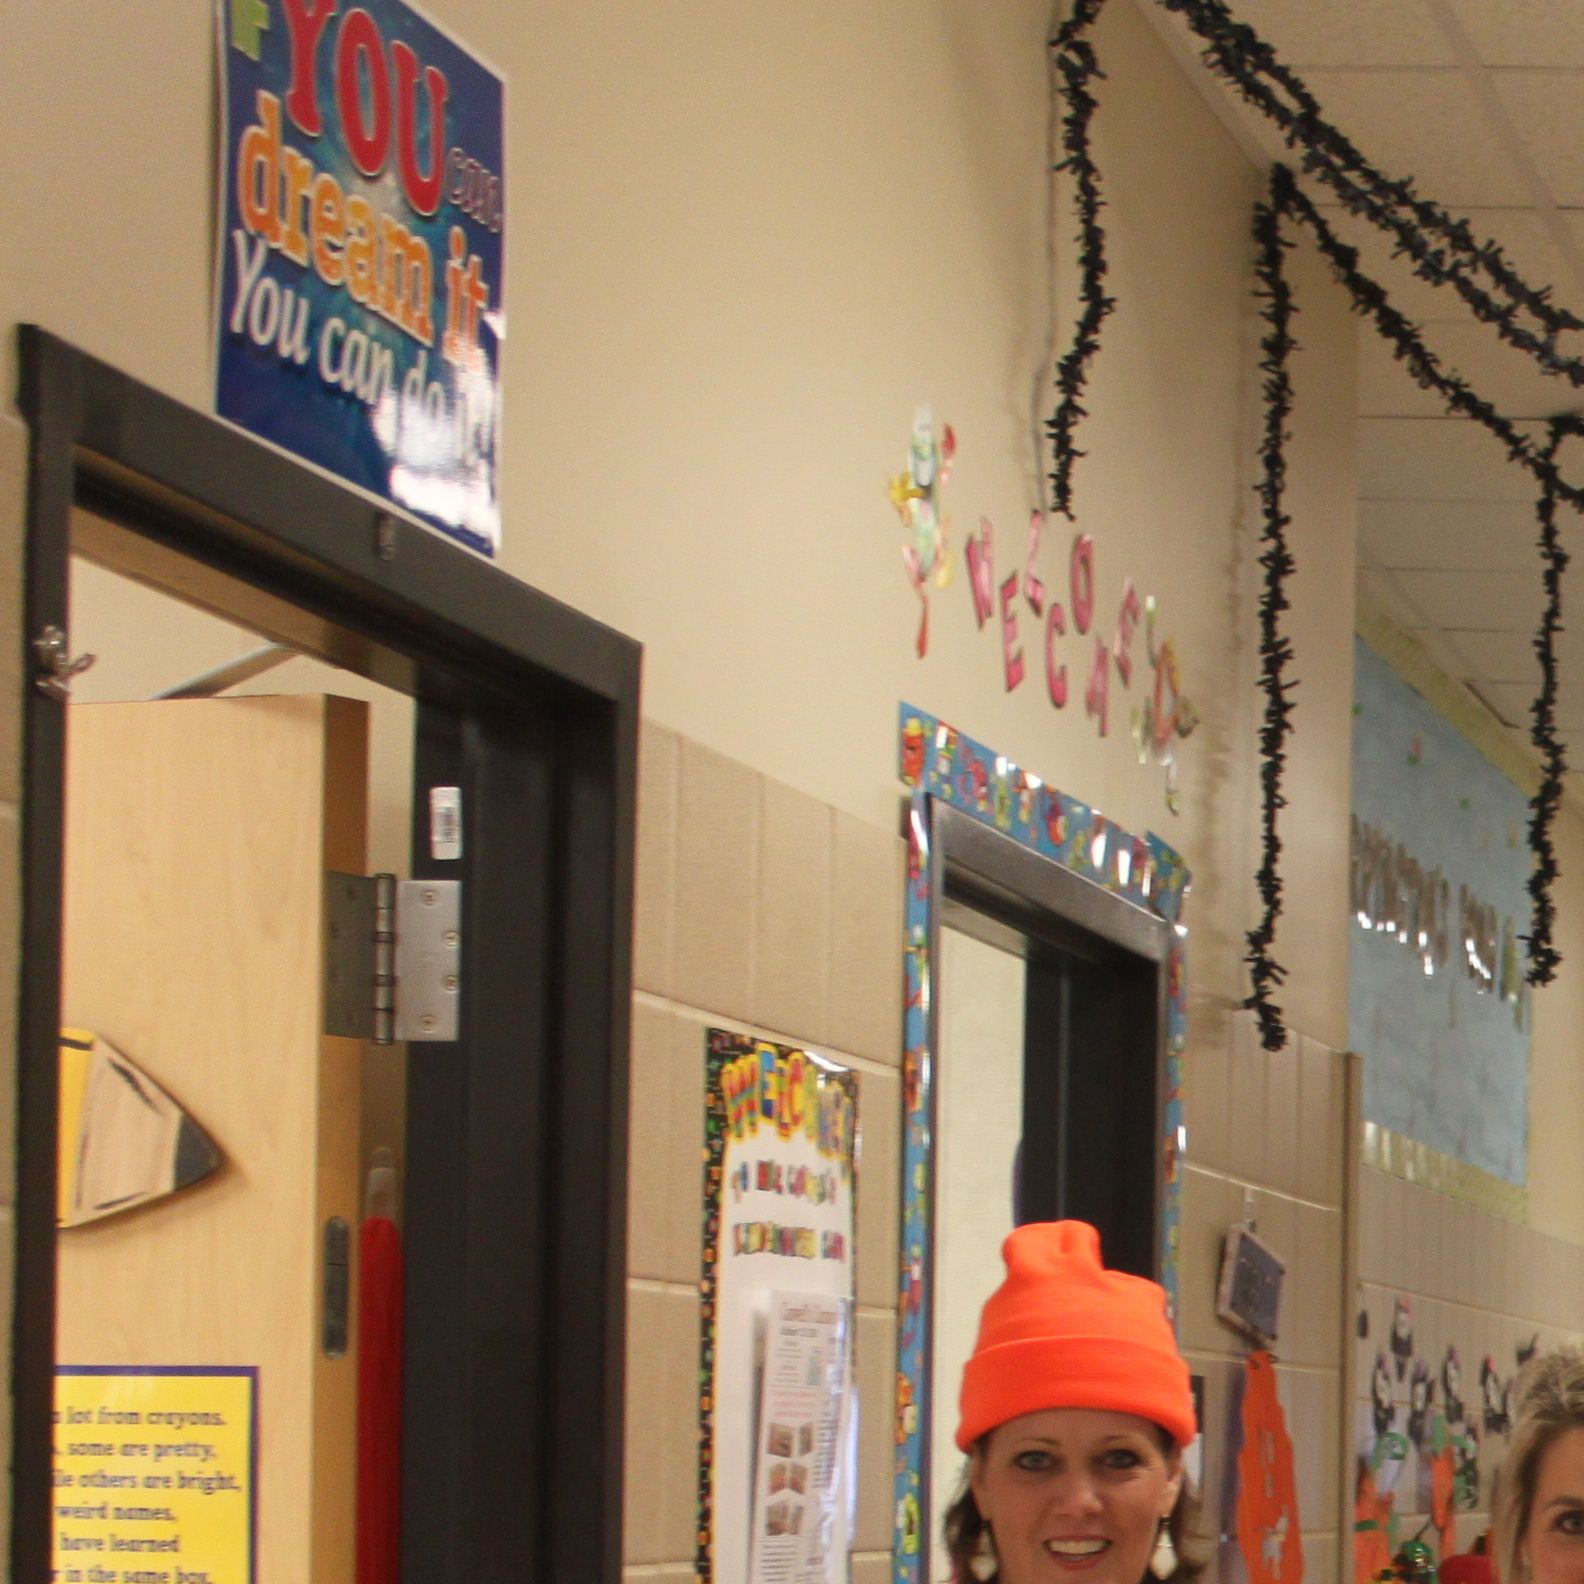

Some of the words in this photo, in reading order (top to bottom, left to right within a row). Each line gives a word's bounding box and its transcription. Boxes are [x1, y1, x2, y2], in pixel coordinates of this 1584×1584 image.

[281, 0, 450, 217] YOU
[235, 88, 434, 350] dream
[443, 224, 490, 372] it
[228, 228, 311, 366] You
[318, 316, 396, 405] can
[67, 1406, 92, 1425] lot
[97, 1406, 140, 1425] from
[146, 1411, 227, 1430] crayons.
[67, 1443, 114, 1457] some
[120, 1443, 149, 1457] are
[79, 1470, 138, 1488] others
[143, 1475, 173, 1489] are
[55, 1502, 107, 1519] weird
[60, 1532, 105, 1551] have
[109, 1533, 180, 1553] learned
[65, 1564, 82, 1583] in
[87, 1564, 117, 1584] the
[122, 1570, 170, 1584] same
